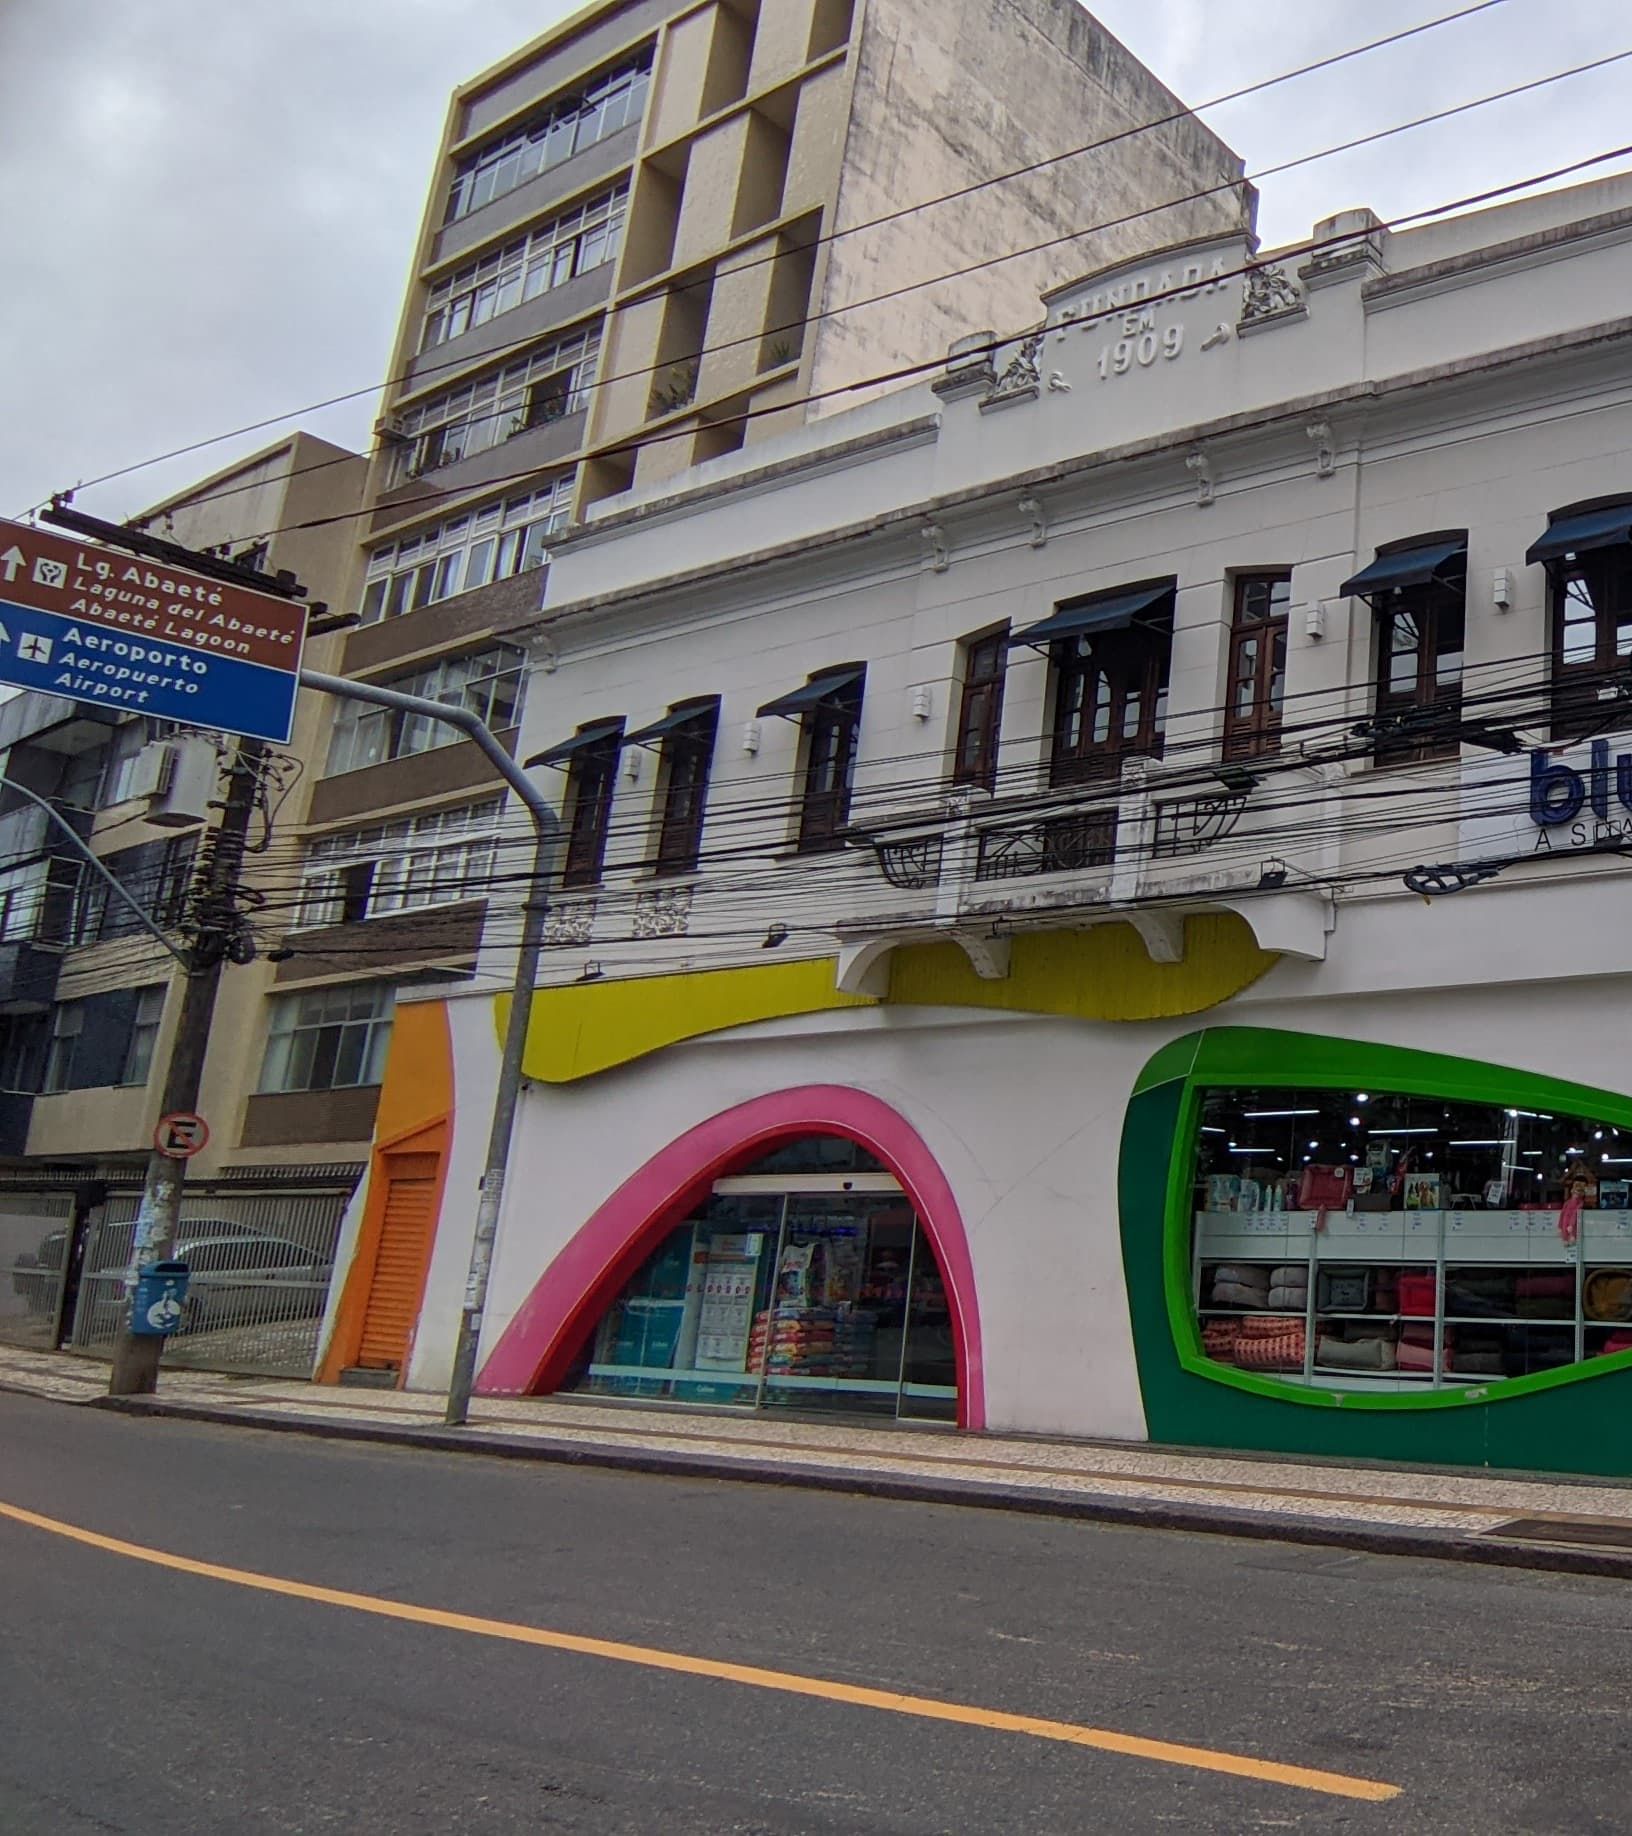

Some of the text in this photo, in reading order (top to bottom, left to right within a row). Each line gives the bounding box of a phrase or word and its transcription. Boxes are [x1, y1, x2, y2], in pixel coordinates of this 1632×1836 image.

[1056, 256, 1228, 343] FUNDADA
[1123, 309, 1156, 339] EM
[1098, 324, 1185, 381] 1909
[76, 552, 223, 606] Lg. Abaeté
[70, 598, 252, 654] Abaeté Lagoon
[73, 576, 296, 645] Laguna del Abaeté
[58, 651, 200, 694] Aeropuerto
[62, 627, 208, 675] Aeroporto
[55, 672, 152, 704] Airport
[1535, 828, 1552, 852] A
